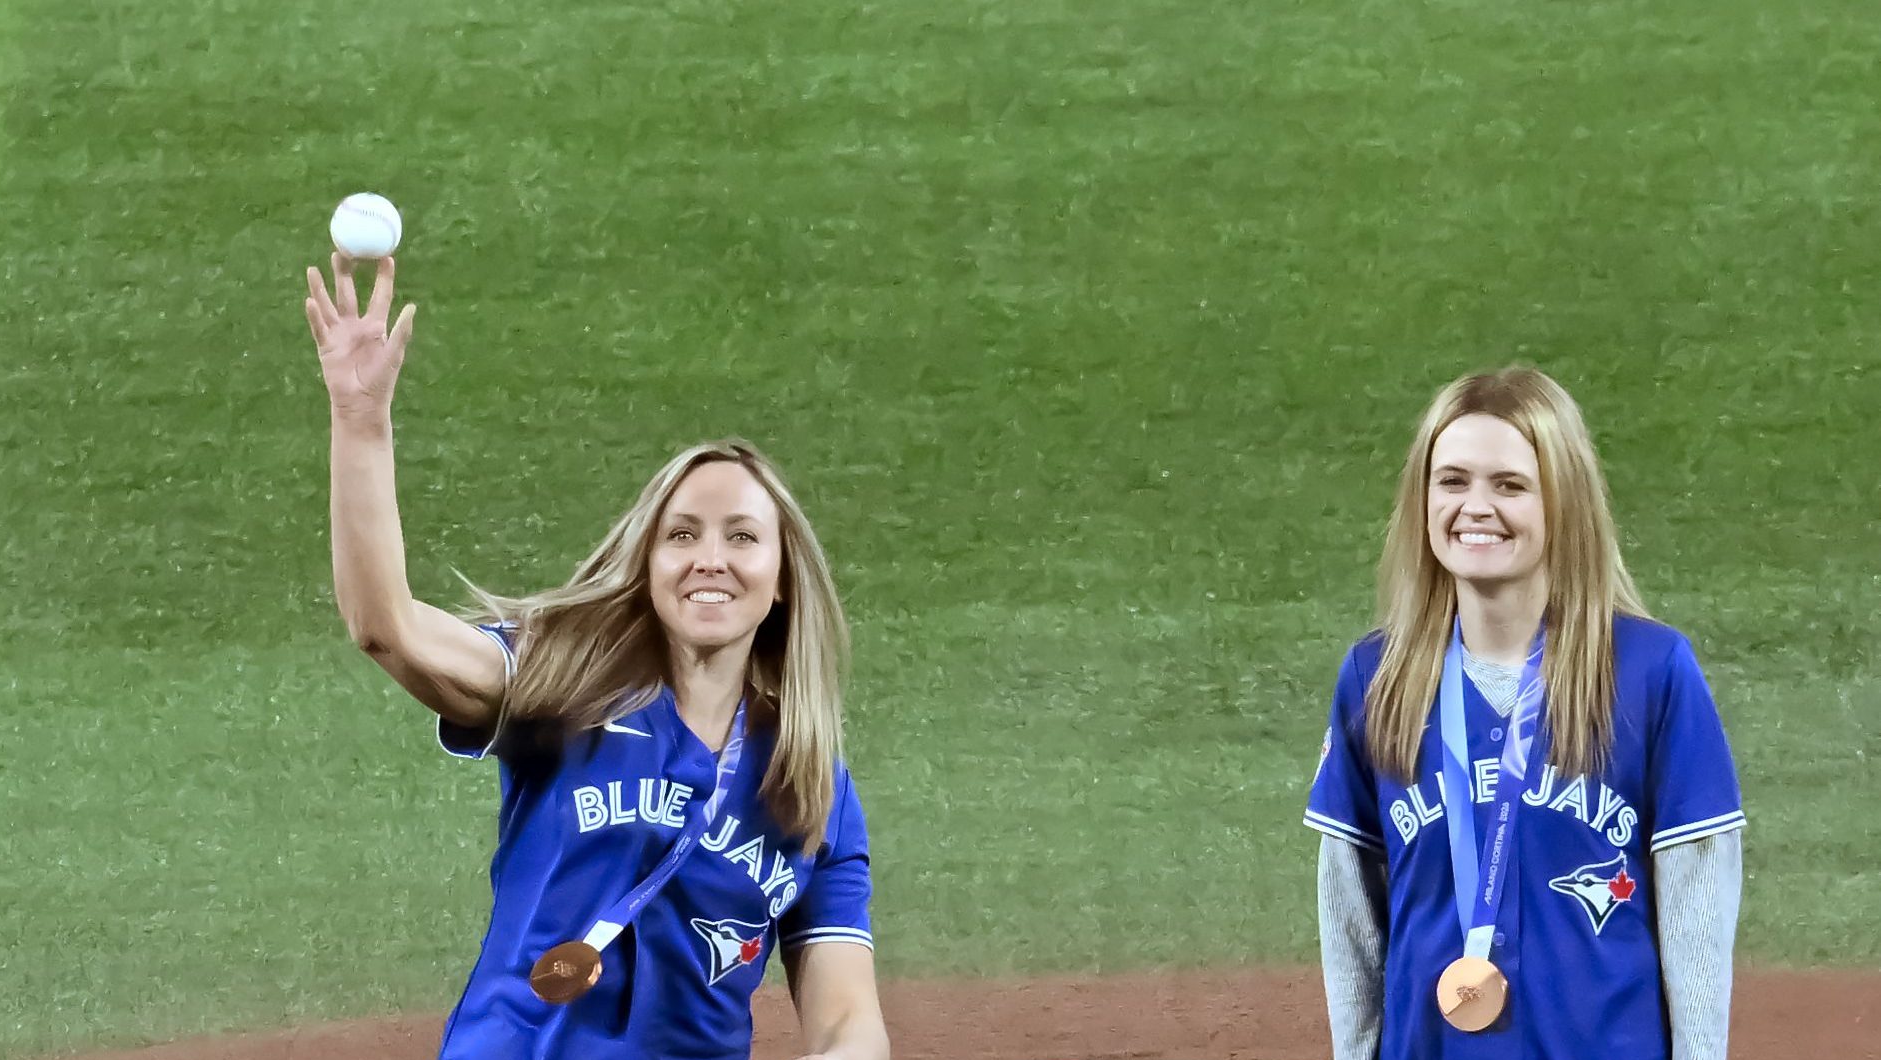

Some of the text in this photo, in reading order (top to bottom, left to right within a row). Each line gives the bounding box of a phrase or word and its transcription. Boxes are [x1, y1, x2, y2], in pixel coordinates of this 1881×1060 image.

[573, 778, 694, 833] BLUE
[699, 814, 798, 918] JAYS
[1521, 763, 1638, 847] JAYS
